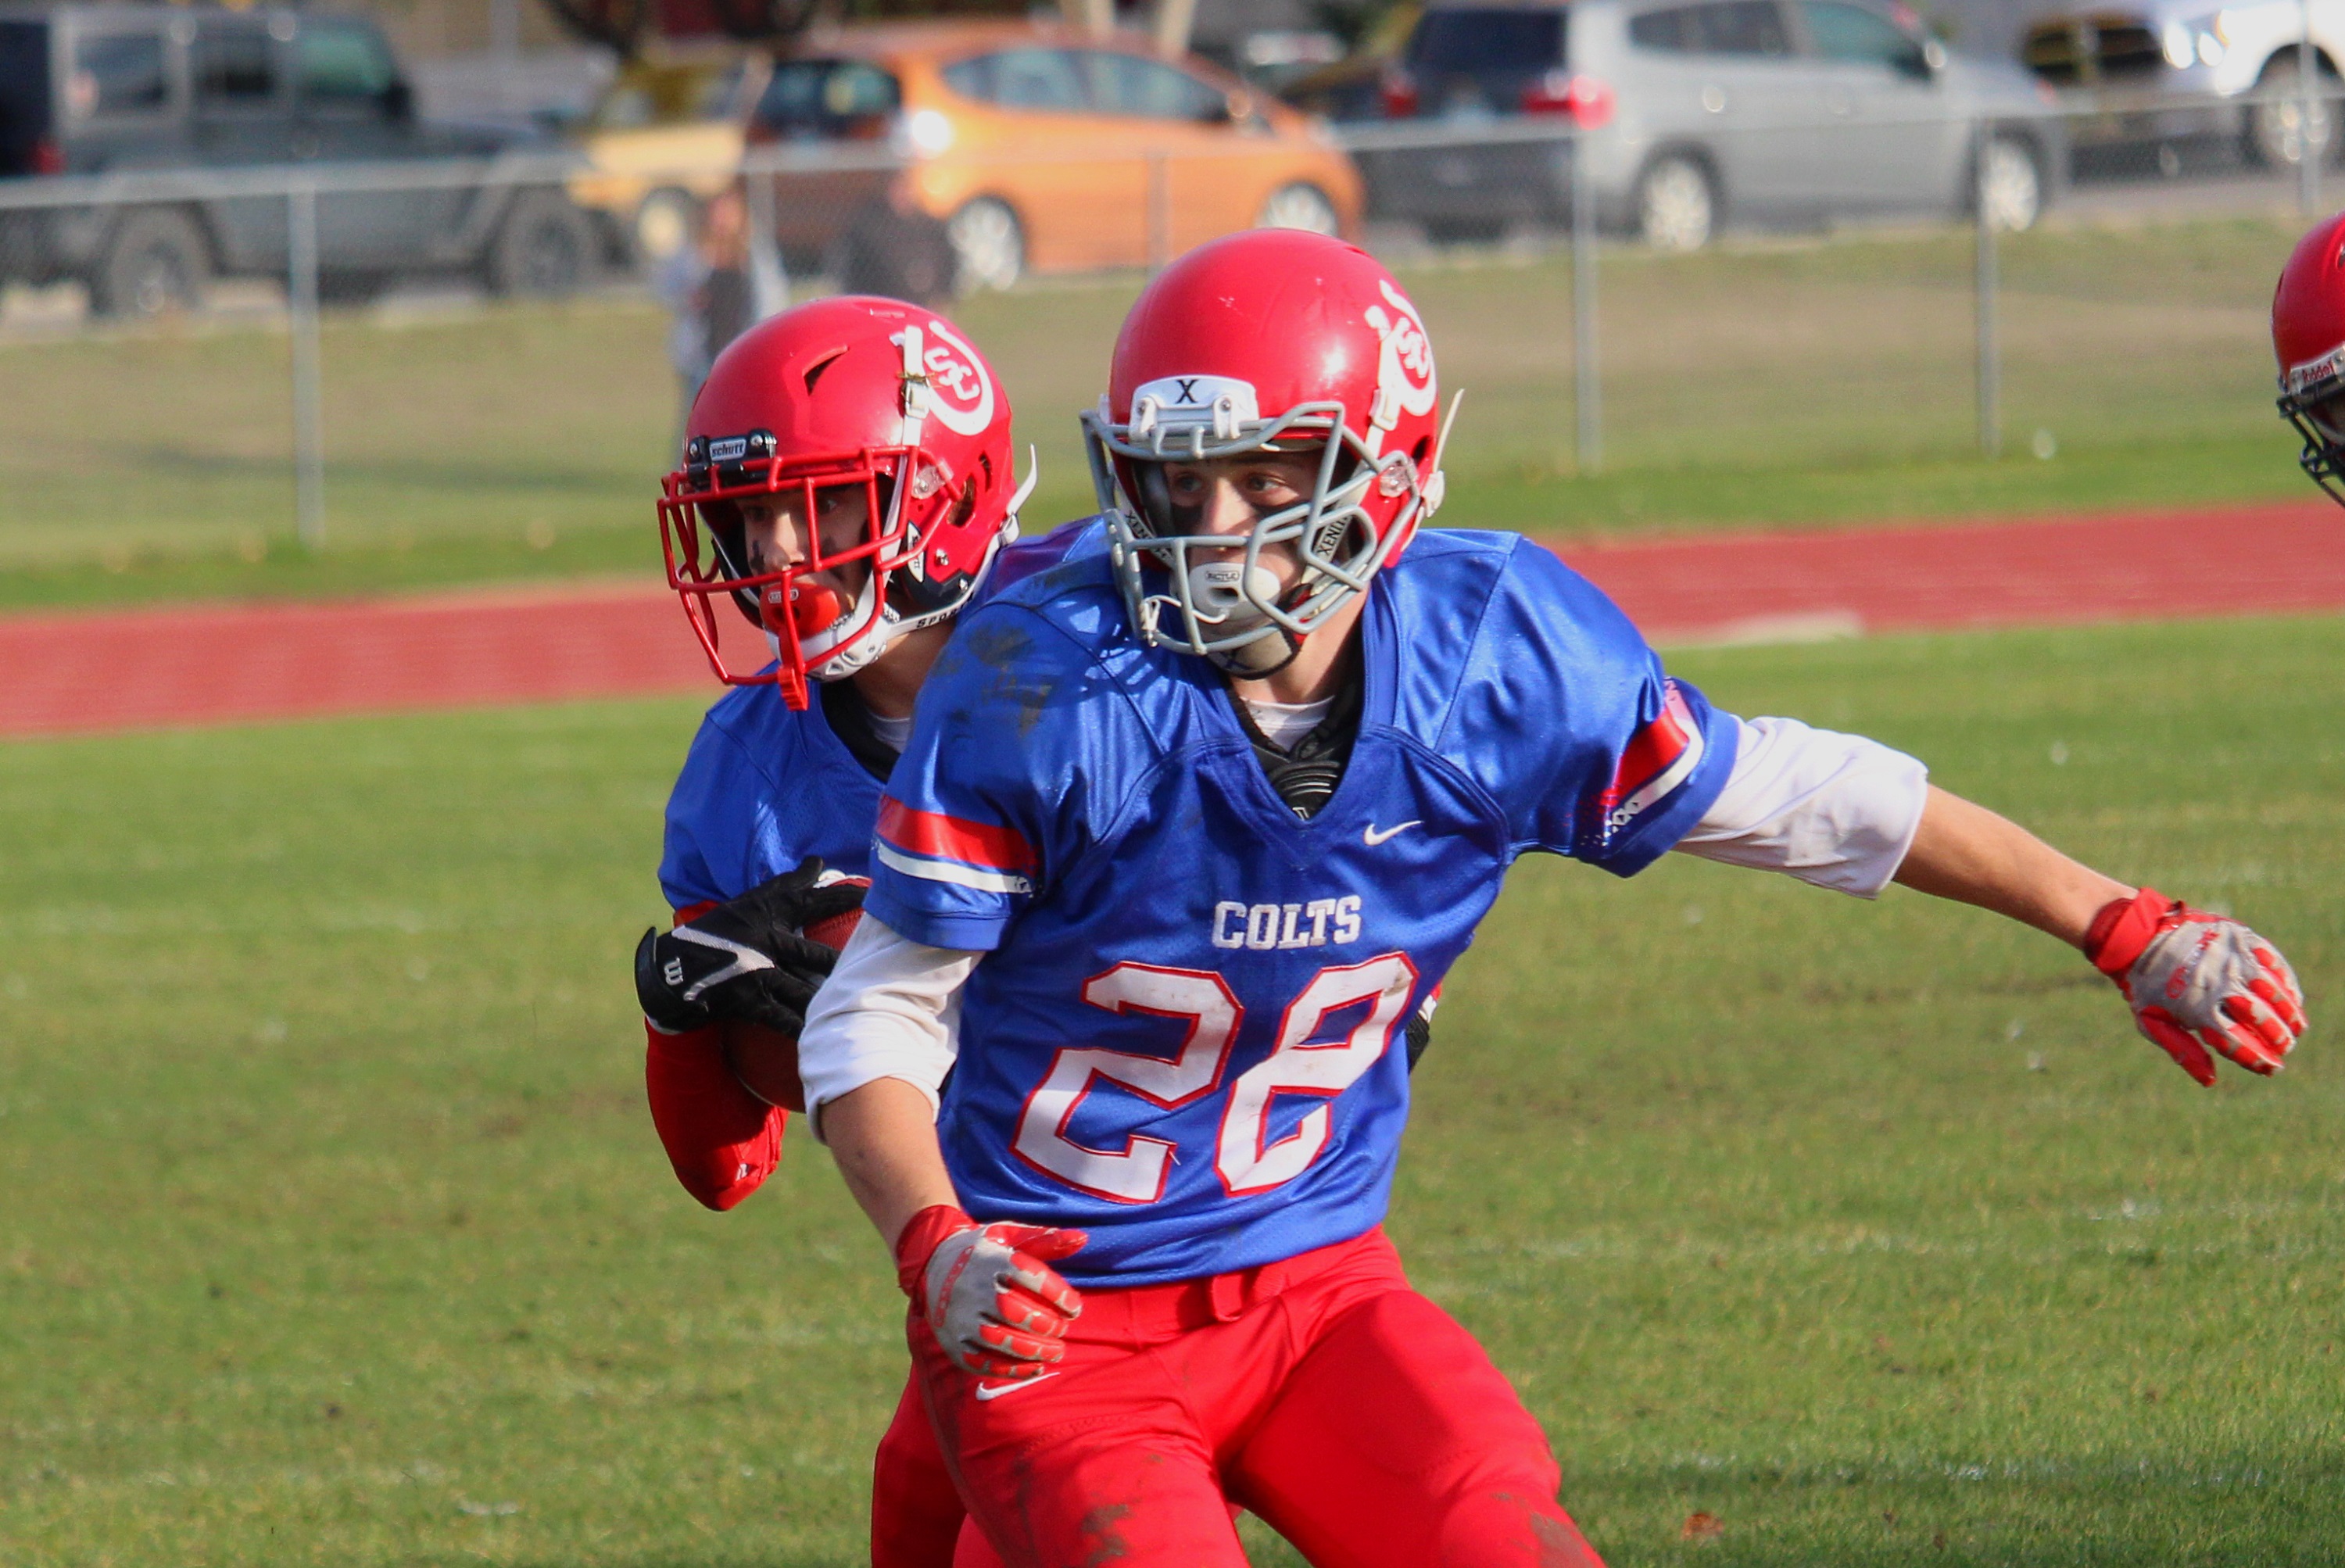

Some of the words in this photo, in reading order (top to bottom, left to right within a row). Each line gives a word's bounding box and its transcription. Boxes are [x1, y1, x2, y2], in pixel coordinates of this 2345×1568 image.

[924, 347, 981, 401] SC
[1175, 379, 1198, 404] X
[1212, 895, 1362, 950] COLTS
[1008, 951, 1420, 1205] 28
